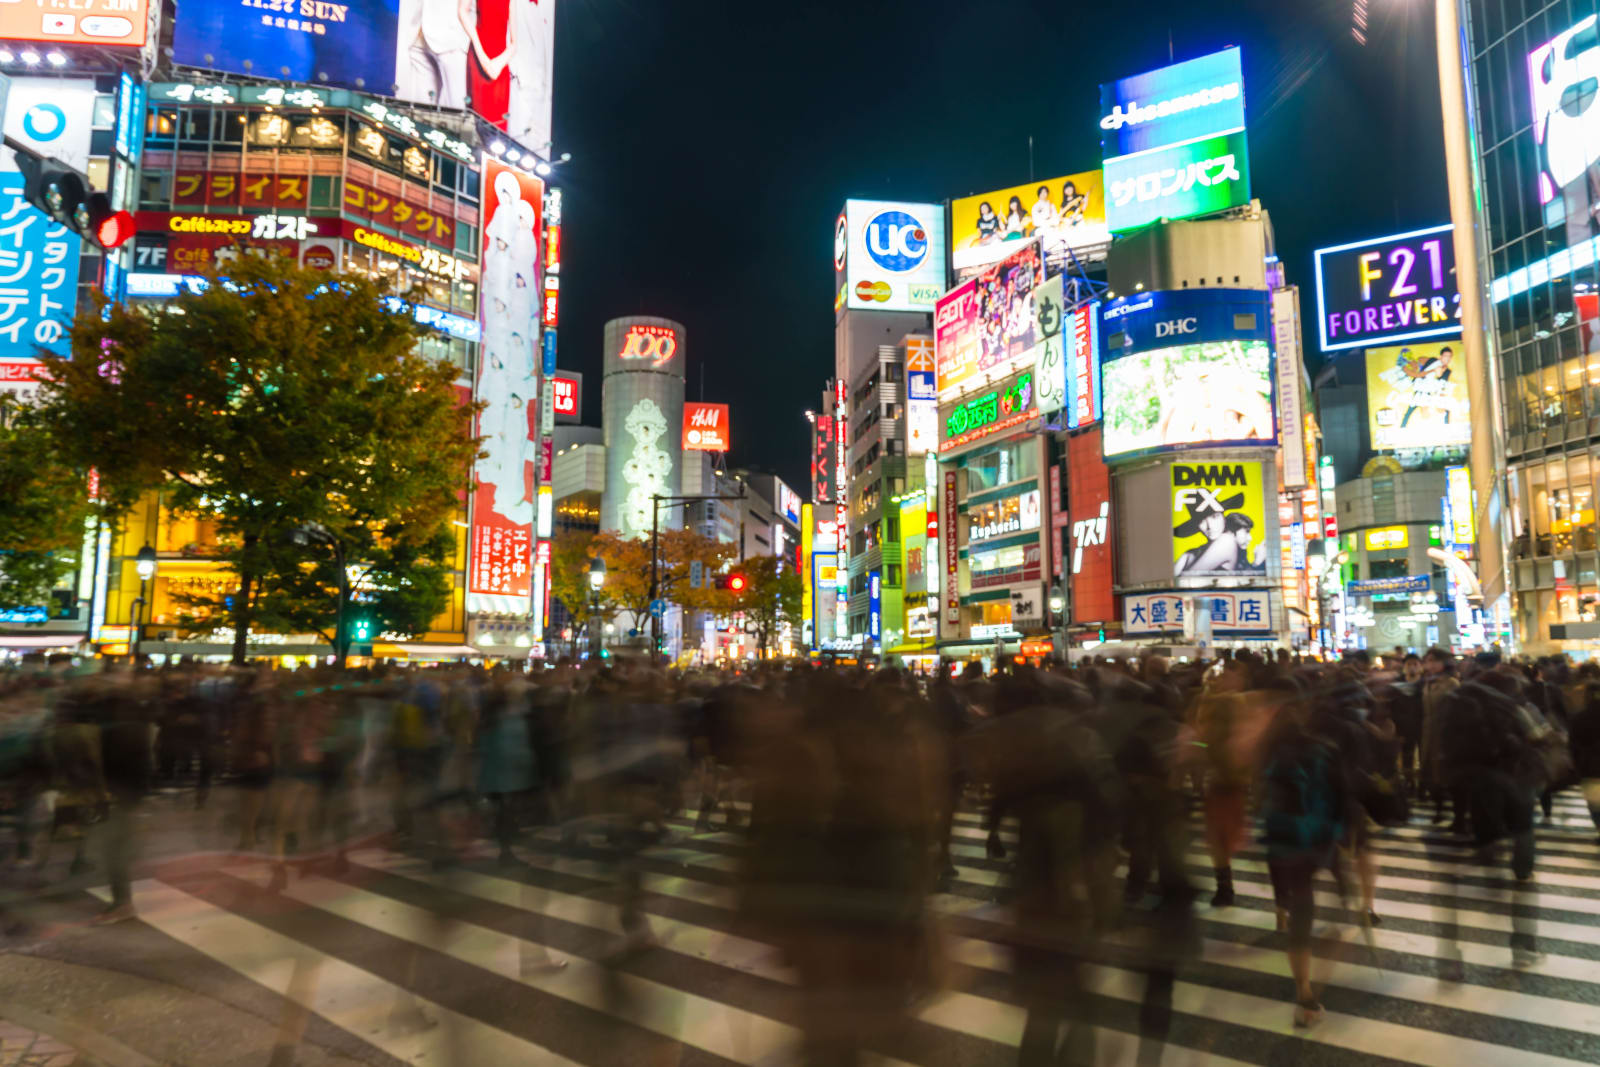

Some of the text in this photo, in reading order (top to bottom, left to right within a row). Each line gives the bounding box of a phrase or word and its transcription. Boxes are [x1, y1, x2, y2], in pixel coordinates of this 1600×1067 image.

[299, 0, 349, 22] SUN
[176, 174, 303, 200] プライス
[1110, 154, 1240, 208] サロンパス
[344, 182, 452, 239] コンタクト
[252, 214, 318, 241] ガスト
[136, 246, 167, 266] 7F
[420, 248, 471, 281] ガスト
[1359, 239, 1444, 301] F21
[34, 216, 69, 344] ンタクトの
[912, 288, 940, 299] VISA
[937, 289, 975, 329] GOT7
[1328, 296, 1448, 338] FOREVER
[1155, 318, 1198, 338] DHC
[619, 333, 677, 367] 109
[1038, 296, 1064, 404] もんじゃ
[691, 408, 720, 427] H&M
[1173, 465, 1247, 486] DMM
[1174, 488, 1225, 512] FX
[970, 518, 1021, 540] Euphoria
[1073, 501, 1109, 574] クスリ
[512, 529, 528, 578] エビ中
